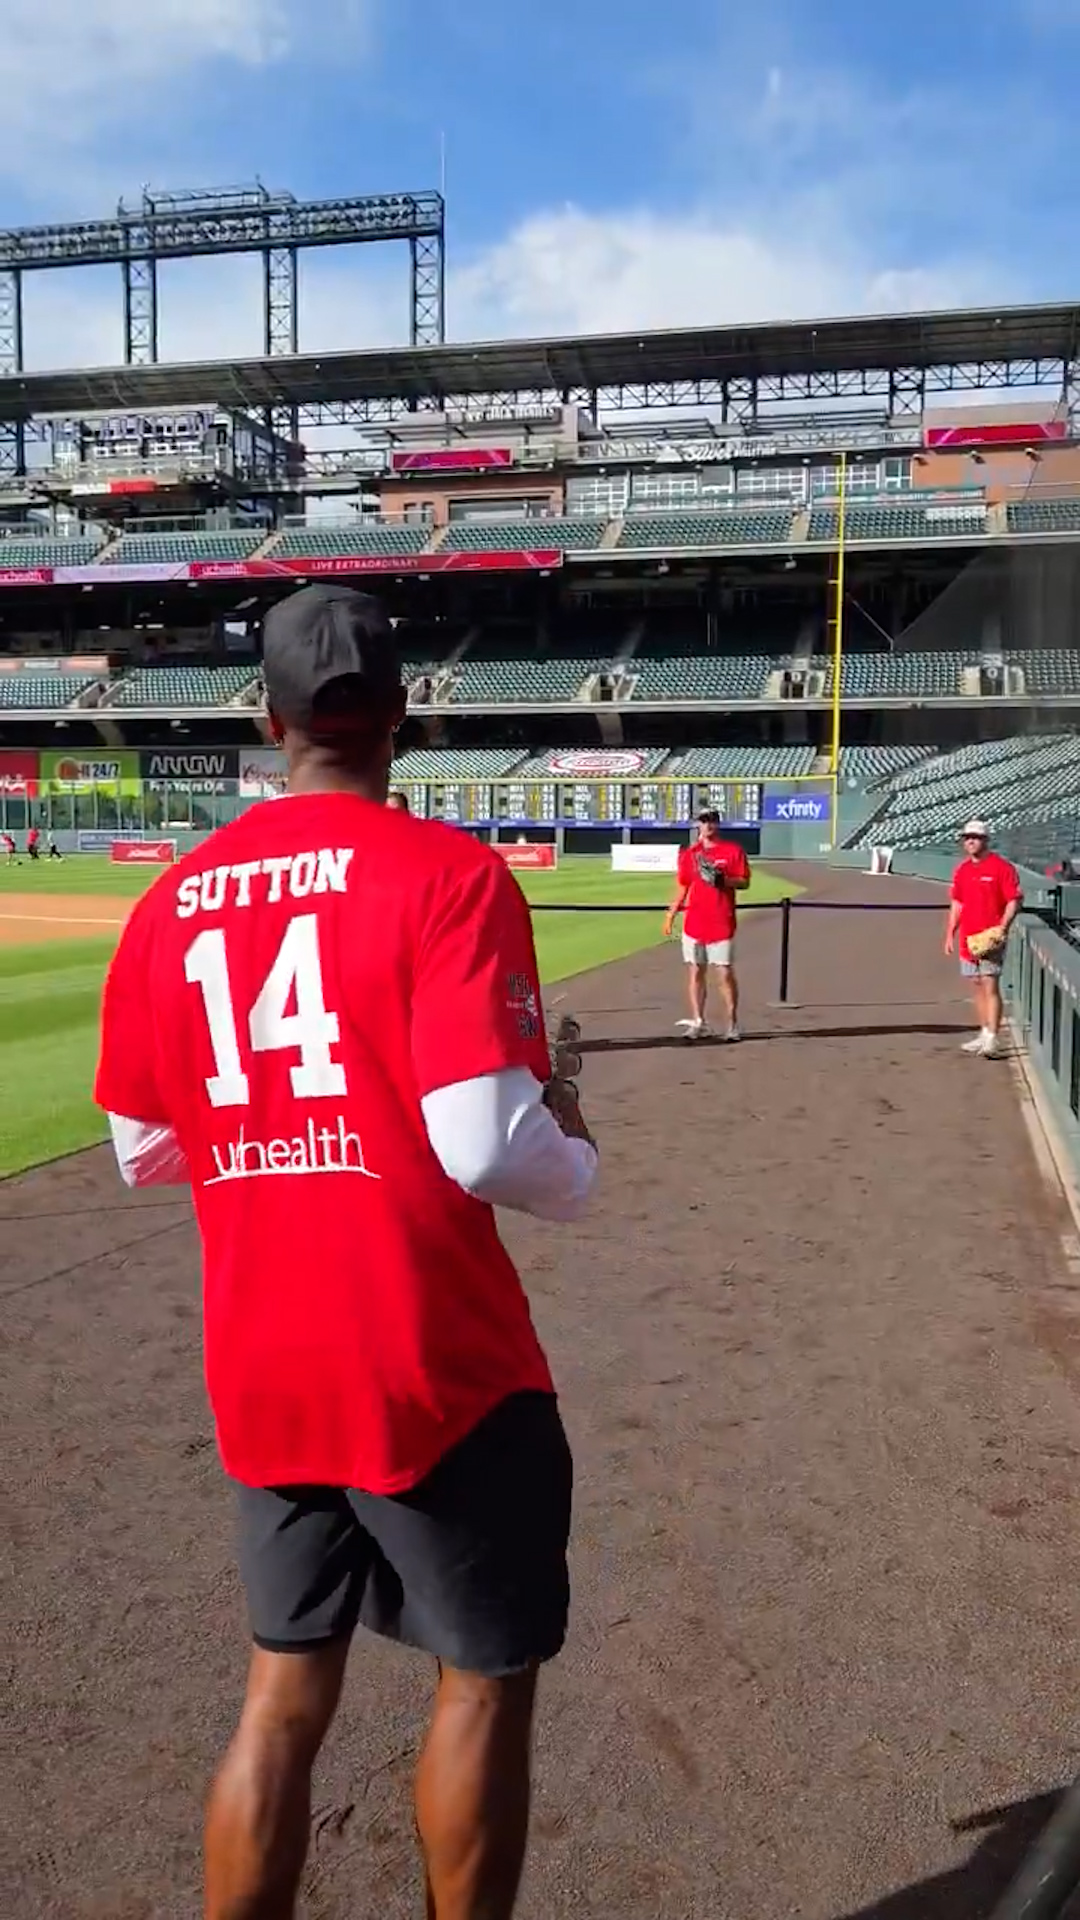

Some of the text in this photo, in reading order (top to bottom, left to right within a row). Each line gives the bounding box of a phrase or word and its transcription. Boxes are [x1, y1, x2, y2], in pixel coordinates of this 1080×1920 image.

[311, 559, 418, 571] LIVE EXTRAORDINARY
[149, 756, 225, 774] ARROW
[776, 799, 822, 819] xfinity
[176, 848, 354, 918] SUTTON
[184, 913, 348, 1108] 14
